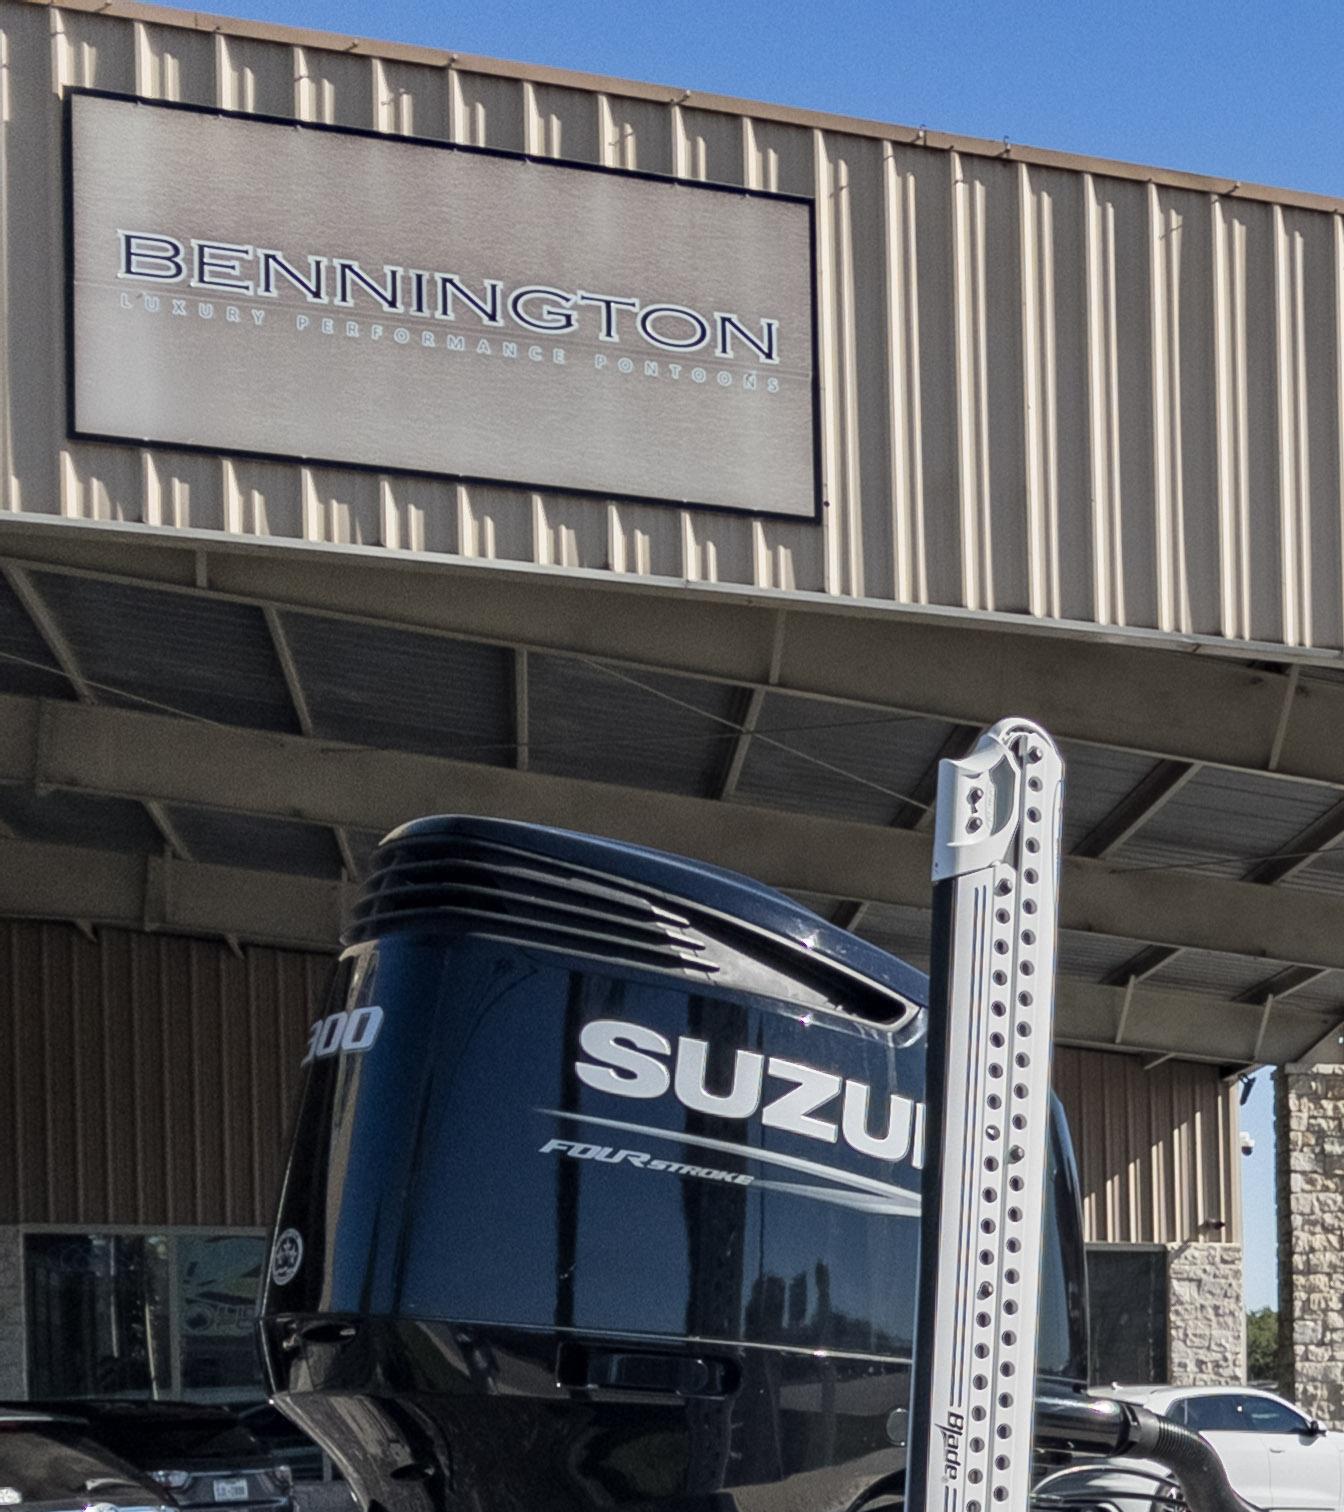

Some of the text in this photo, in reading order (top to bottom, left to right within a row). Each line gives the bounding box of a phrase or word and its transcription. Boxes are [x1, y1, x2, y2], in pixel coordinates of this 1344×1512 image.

[117, 228, 781, 364] BENNINGTON
[120, 292, 780, 394] LUXURY PERFORMANCE PONTOONS
[574, 1017, 925, 1170] SUZU
[934, 1411, 965, 1481] Blade
